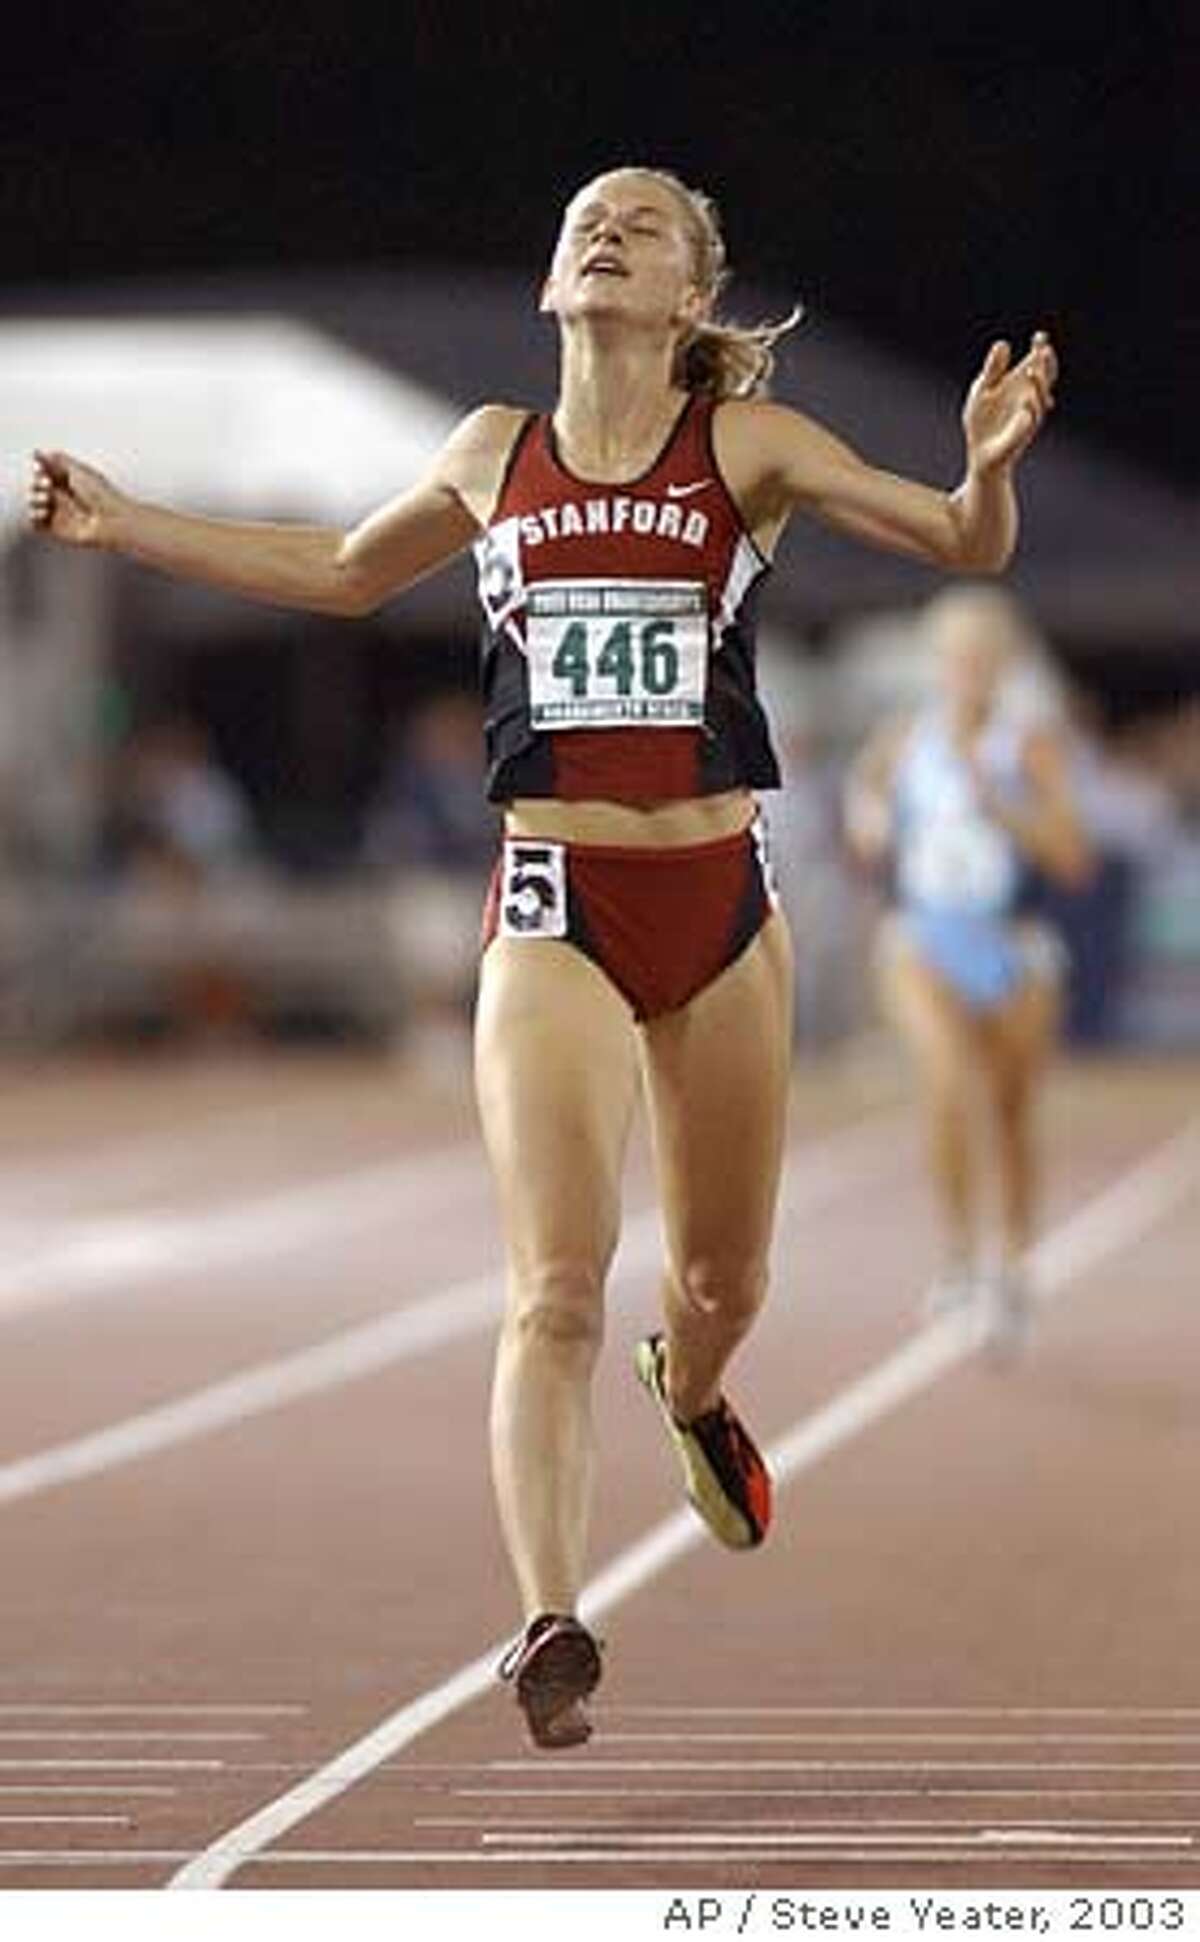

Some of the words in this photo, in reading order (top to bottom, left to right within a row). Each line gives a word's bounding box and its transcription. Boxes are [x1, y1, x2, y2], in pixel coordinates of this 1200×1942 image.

[520, 498, 708, 548] STANFORD
[550, 621, 680, 697] 446
[504, 849, 556, 931] 5
